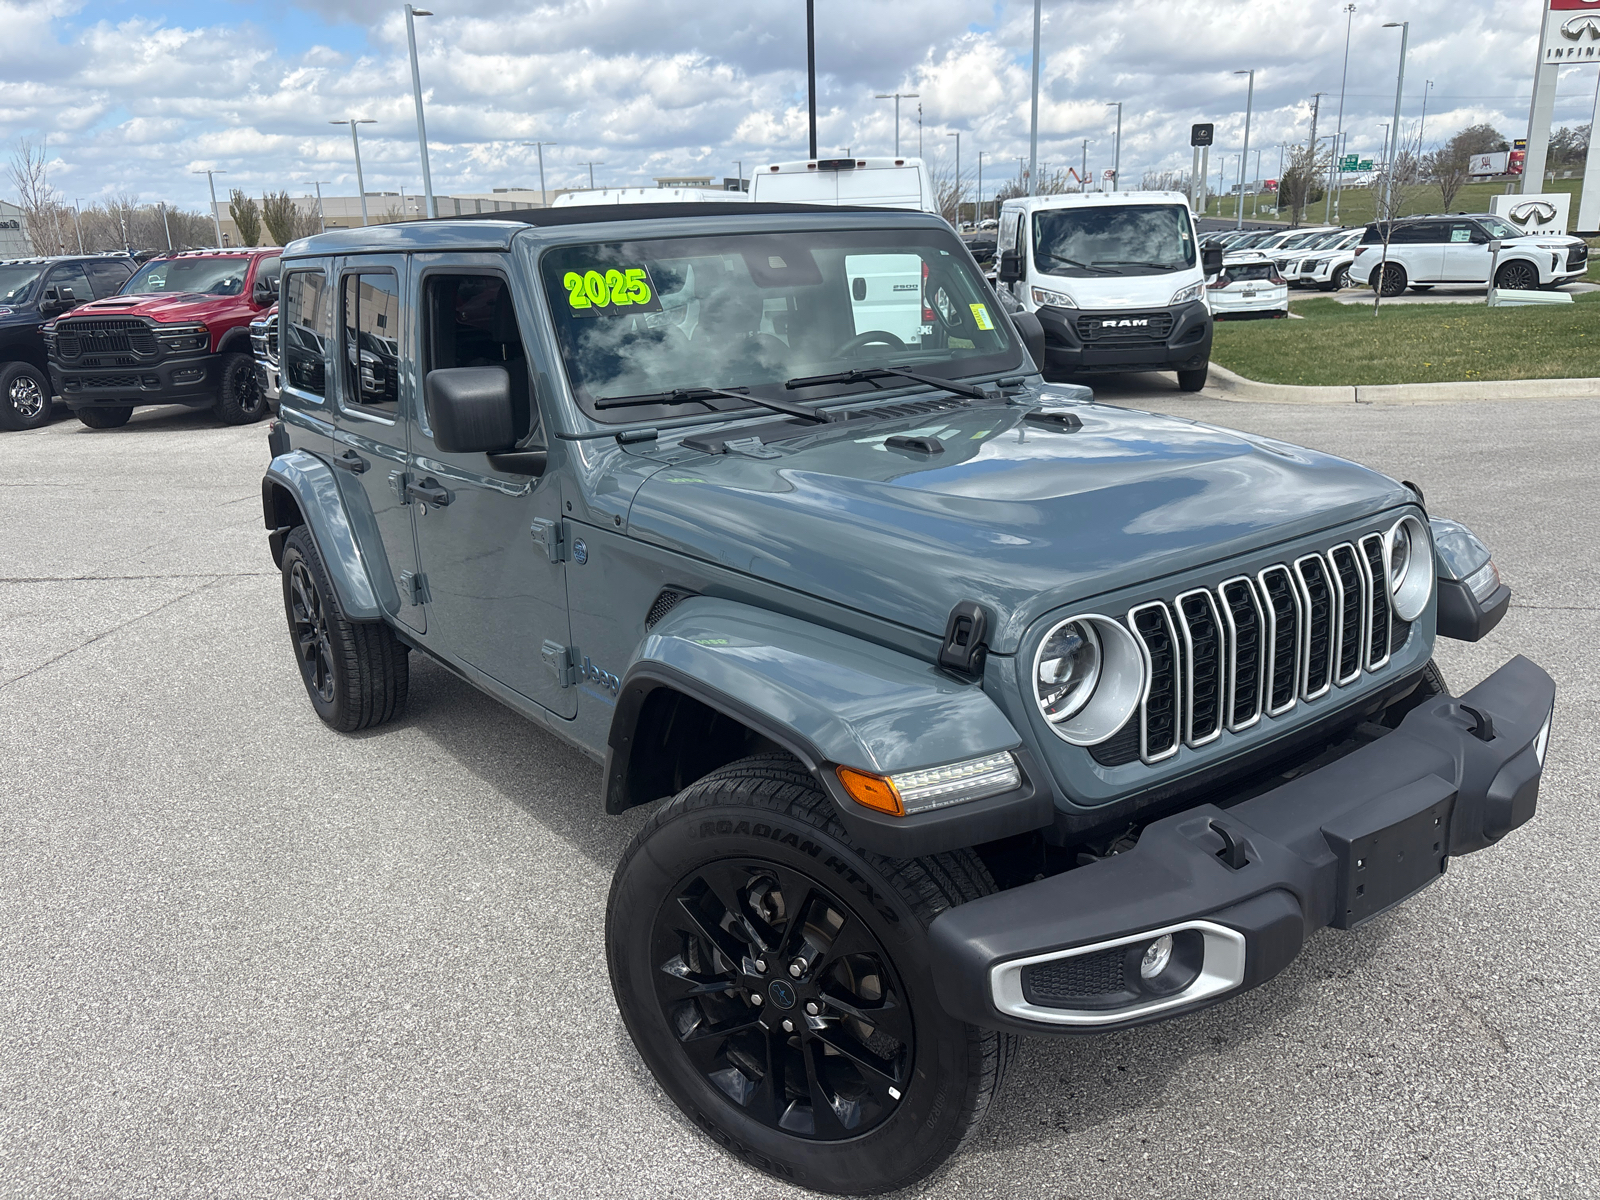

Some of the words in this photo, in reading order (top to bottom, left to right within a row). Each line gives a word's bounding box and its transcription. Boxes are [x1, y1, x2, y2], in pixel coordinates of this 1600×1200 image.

[563, 269, 652, 309] 2025
[1102, 319, 1148, 328] RAM
[579, 655, 621, 698] Jeep
[699, 820, 823, 858] ROADIAN
[695, 1111, 794, 1178] NEXEN
